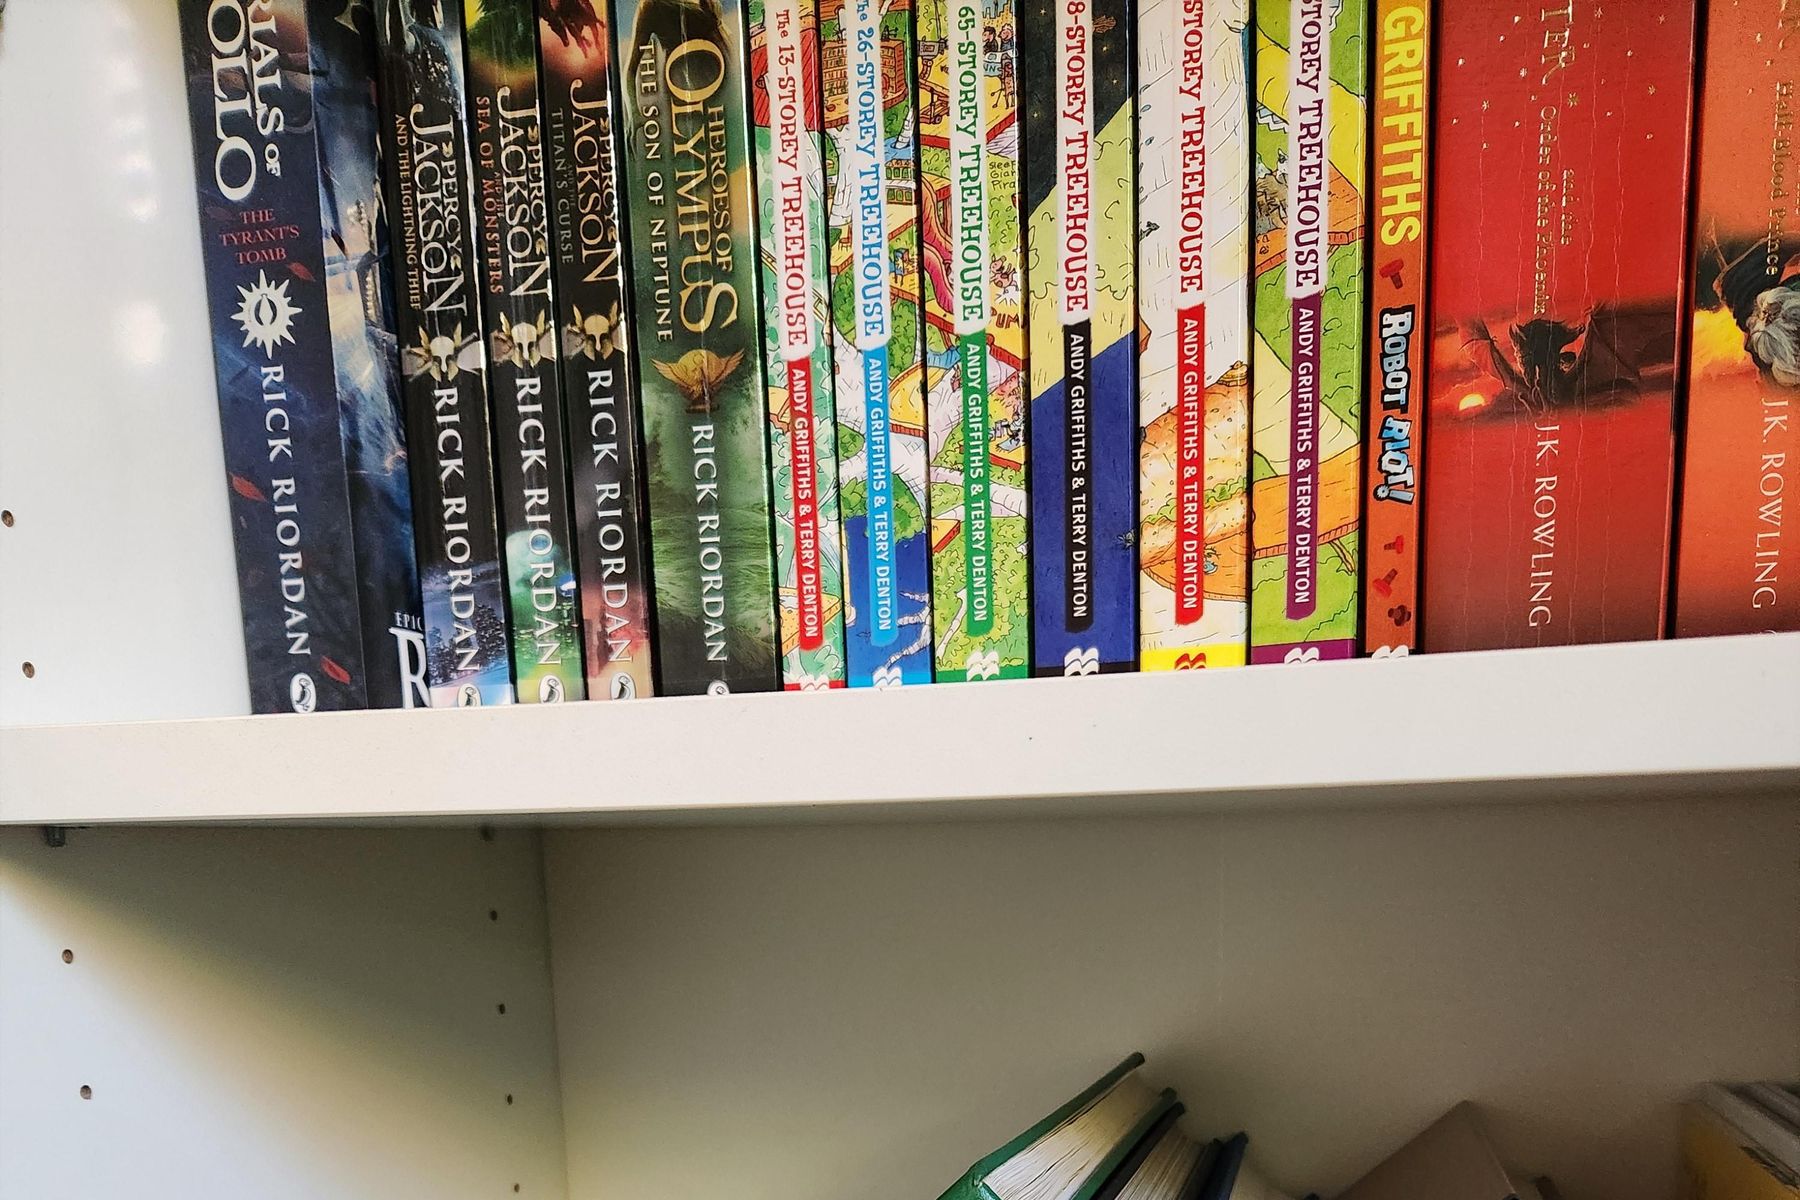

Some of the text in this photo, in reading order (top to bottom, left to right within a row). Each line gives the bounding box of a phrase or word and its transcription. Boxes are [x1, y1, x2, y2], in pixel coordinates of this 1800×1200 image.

[240, 208, 276, 225] THE
[264, 143, 282, 176] OF
[395, 114, 421, 310] AND THE LIGHTNING THIEF
[409, 103, 468, 316] JACKSON
[440, 159, 462, 254] PERCY
[475, 96, 504, 295] SEA OF MONSTERS
[496, 86, 552, 297] JACKSON
[551, 107, 574, 265] TITAN'S CURSE
[569, 78, 622, 283] JACKSON
[637, 41, 674, 343] THE SON OF NEPTUNE
[664, 38, 739, 334] OLYMPUS
[706, 104, 733, 274] HEROES OF
[775, 9, 808, 348] The 13-STOREY TREEHOUSE
[855, 26, 885, 338] 26-STOREY TREEHOUSE
[955, 6, 983, 323] 65-STOREY TREEHOUSE
[1063, 129, 1090, 313] TREEHOUSE
[1177, 106, 1206, 294] TREEHOUSE
[1294, 98, 1325, 289] TREEHOUSE
[1380, 5, 1425, 247] GRIFFITHS
[1533, 105, 1558, 316] Order Phoenix
[1764, 80, 1794, 276] Half-Blood Prince
[219, 226, 300, 247] TYRANT'S
[235, 247, 288, 266] TOMB
[260, 364, 312, 656] RICK RIORDAN
[791, 368, 819, 638] ANDY GRIFFITHS & TERRY DENTON
[867, 357, 891, 631] ANDY GRIFFITHS & TERRY DENTON
[966, 342, 987, 622] ANDY GRIFFITHS & TERRY DENTON
[1070, 333, 1088, 618] ANDY GRIFFITHS & TERRY DENTON
[1182, 318, 1198, 610] ANDY GRIFFITHS & TERRY DENTON
[1294, 307, 1315, 605] ANDY GRIFFITHS & TERRY DENTON
[1376, 310, 1415, 505] ROBOT RIOT!
[1752, 396, 1790, 609] J.K. ROWLING
[433, 387, 480, 672] RICK RIORDAN
[515, 376, 562, 666] RICK RIORDAN
[587, 368, 634, 664] RICK RIORDAN
[691, 424, 728, 663] RICK RIORDAN
[1528, 422, 1561, 628] J.K. ROWLING
